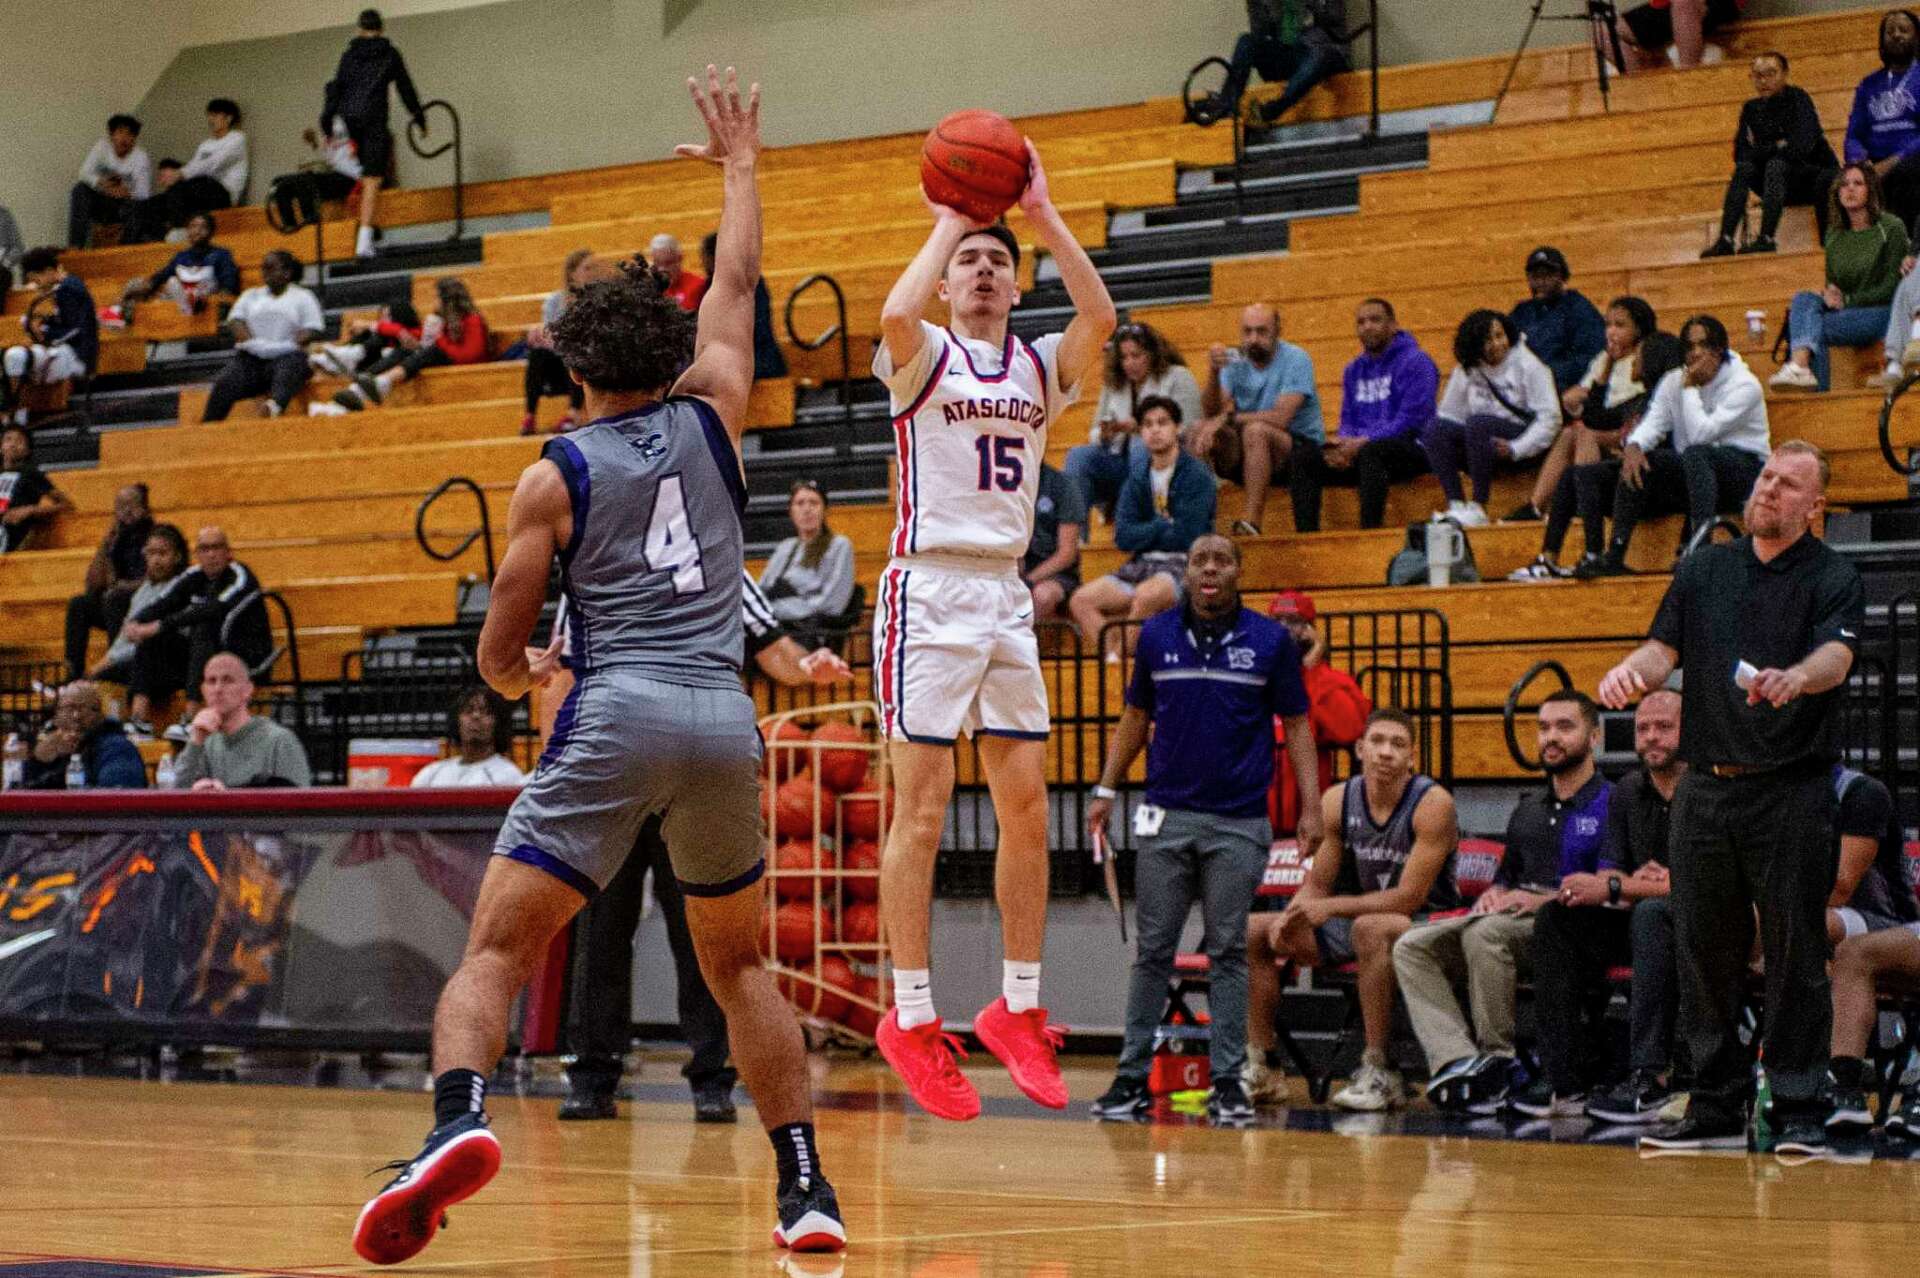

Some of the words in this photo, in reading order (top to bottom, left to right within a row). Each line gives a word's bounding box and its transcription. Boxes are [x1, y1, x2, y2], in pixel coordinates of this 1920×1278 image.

[975, 434, 1024, 492] 15
[641, 470, 708, 598] 4
[1184, 1062, 1199, 1087] G
